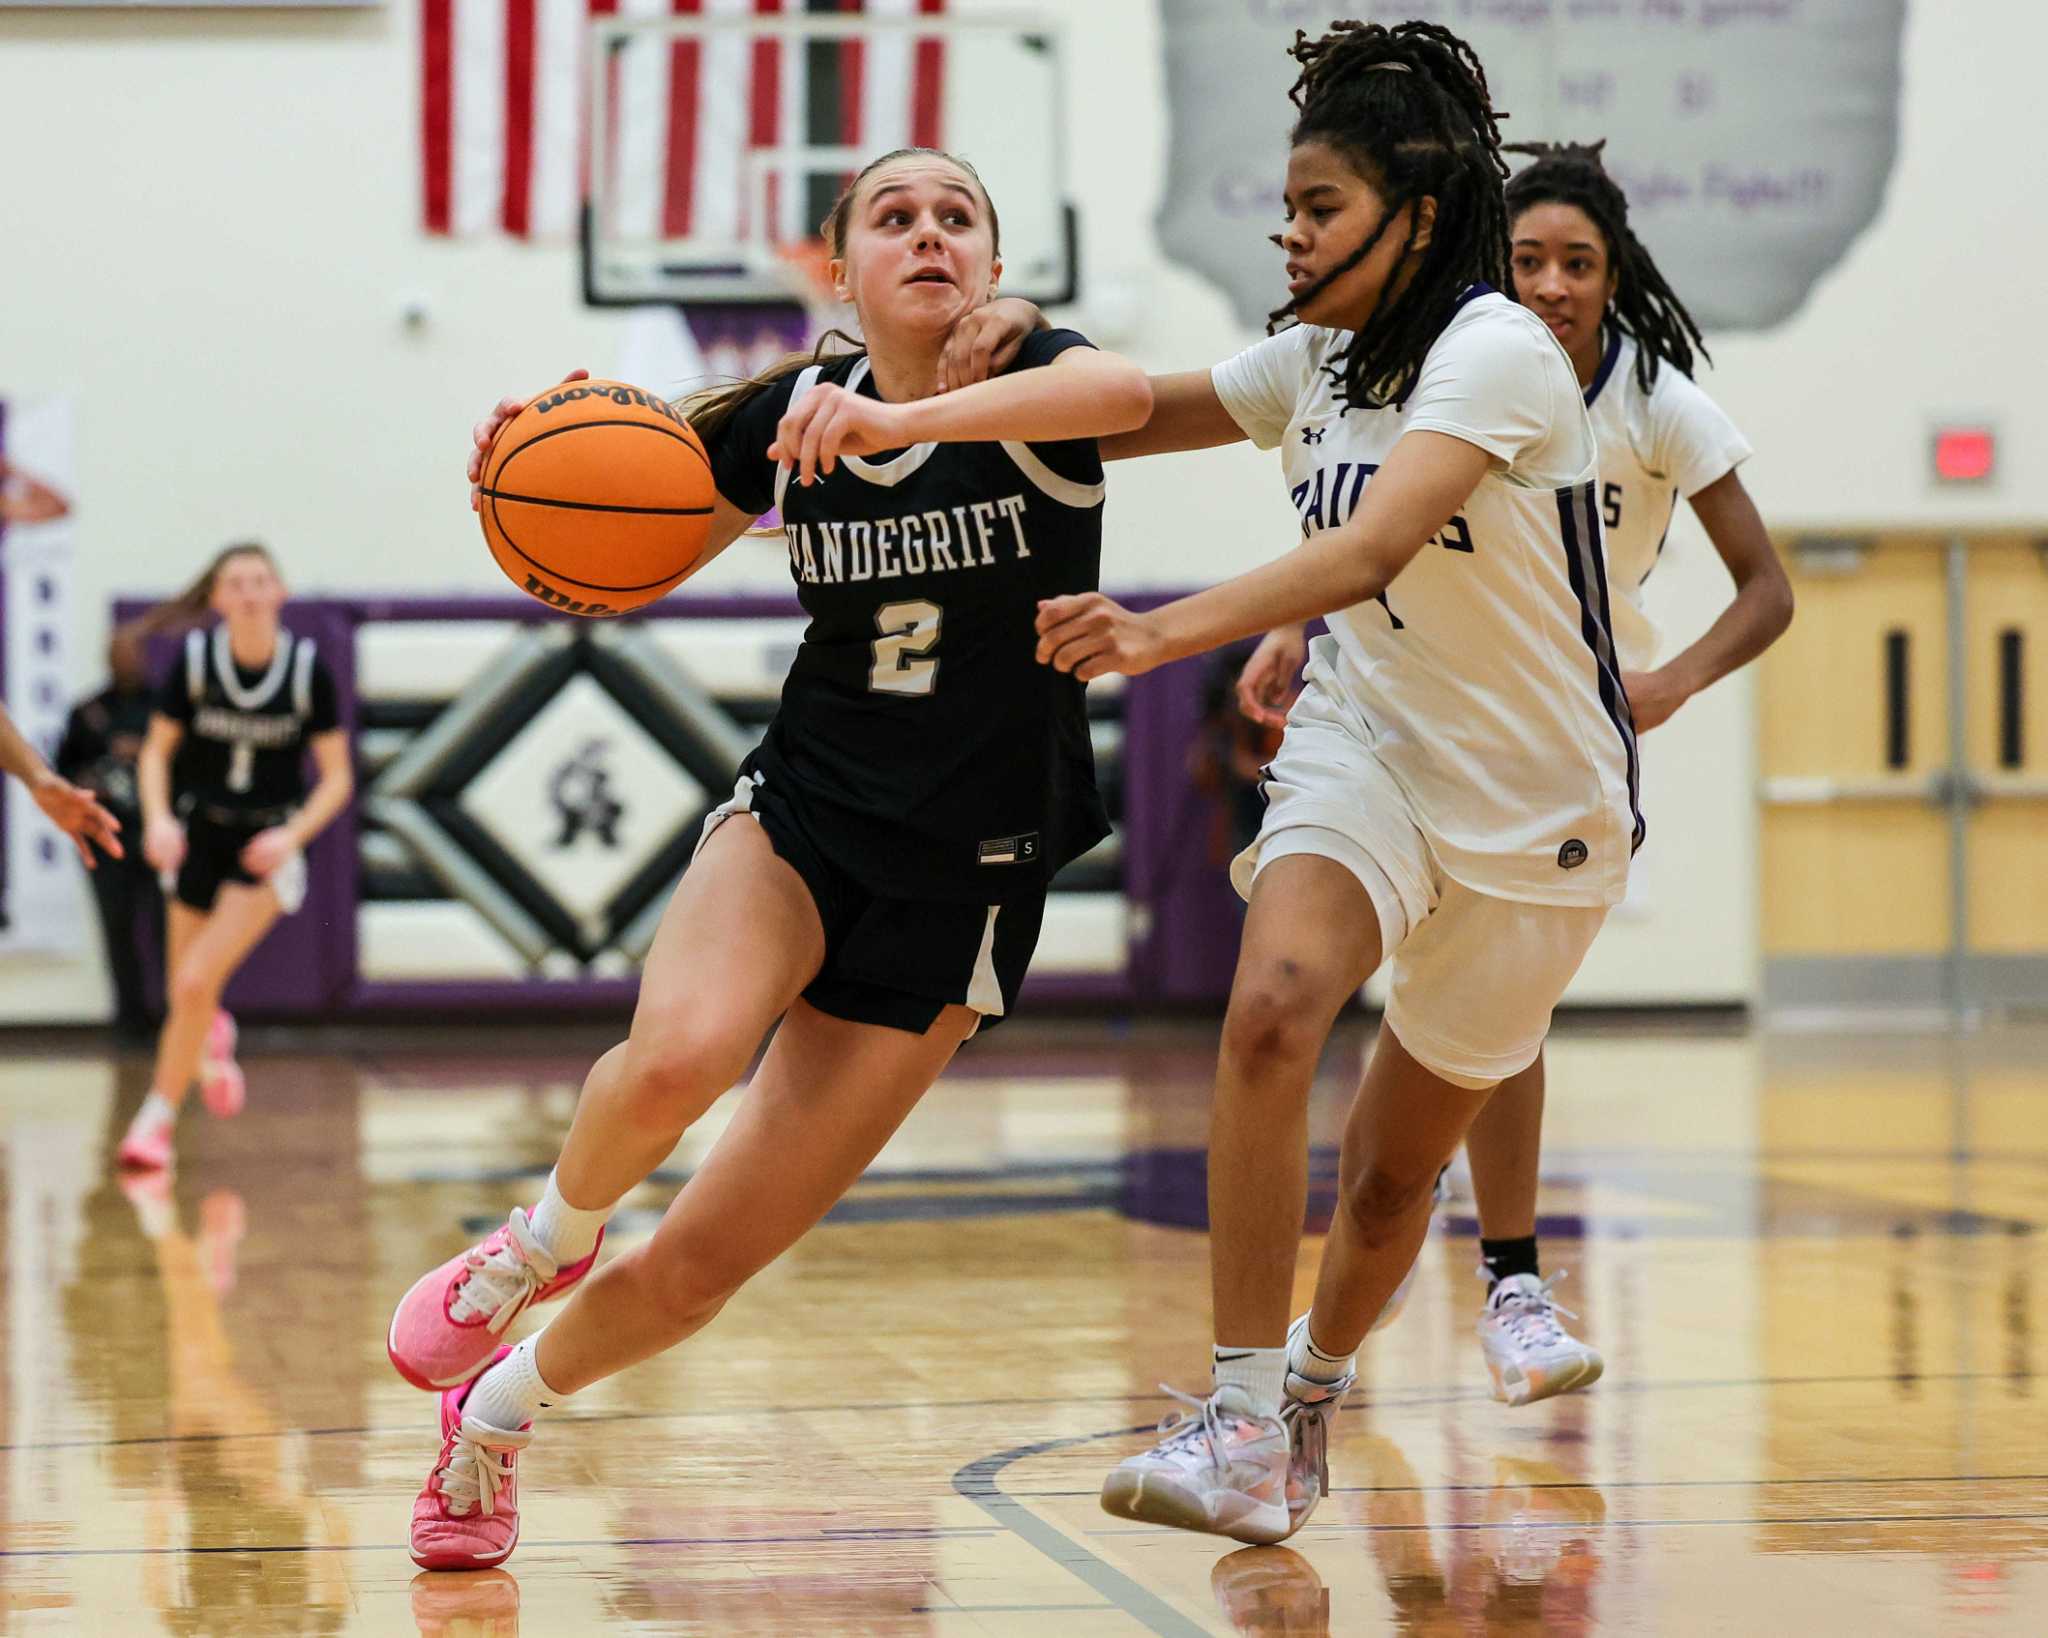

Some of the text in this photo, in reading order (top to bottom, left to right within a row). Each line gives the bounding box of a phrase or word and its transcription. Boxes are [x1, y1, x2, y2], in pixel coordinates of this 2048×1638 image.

[535, 385, 689, 433] Wilson
[785, 494, 1032, 584] VANDEGRIFT
[867, 598, 944, 697] 2
[1023, 841, 1033, 855] S
